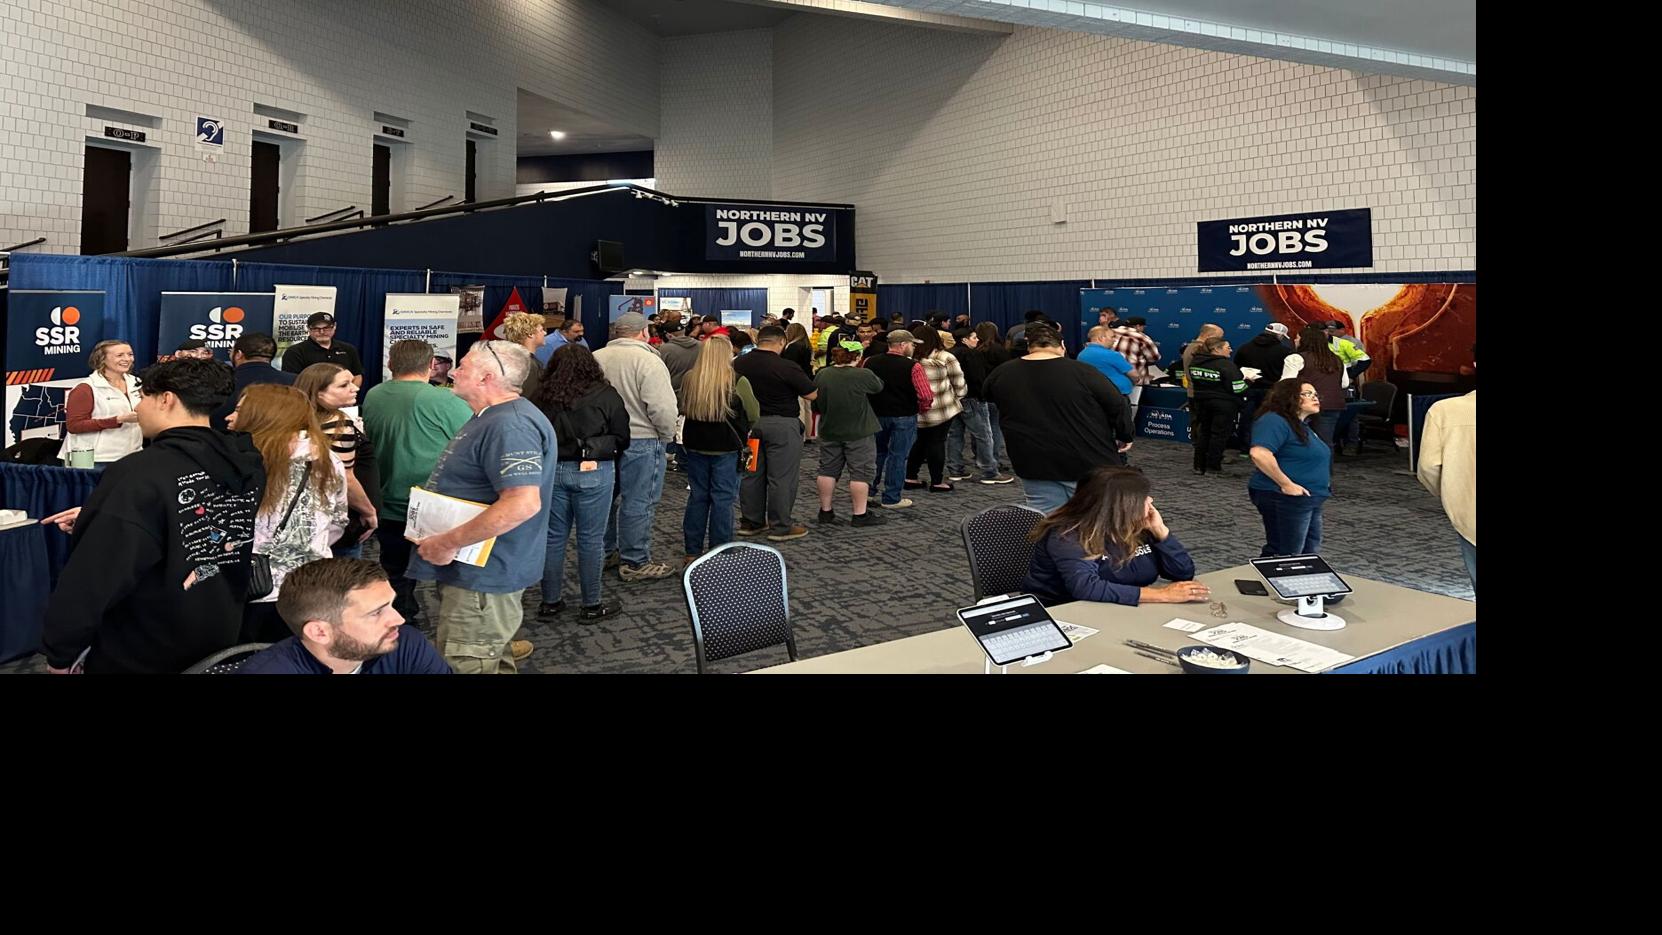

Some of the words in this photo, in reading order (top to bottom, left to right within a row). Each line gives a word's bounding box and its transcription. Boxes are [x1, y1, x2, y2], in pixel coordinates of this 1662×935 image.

[716, 209, 801, 222] NORTHERN
[804, 213, 826, 222] NV
[1229, 219, 1302, 233] NORTHERN
[1307, 218, 1328, 228] NV
[716, 221, 826, 248] JOBS
[1229, 229, 1328, 256] JOBS
[1247, 260, 1312, 269] NORTHERNNVJOBS.COM
[850, 276, 874, 288] CAT
[35, 326, 80, 346] SSR
[189, 324, 244, 340] SSR
[44, 344, 80, 355] MINING
[205, 340, 235, 349] MININ
[1147, 421, 1170, 429] Process
[1144, 427, 1175, 436] Operations
